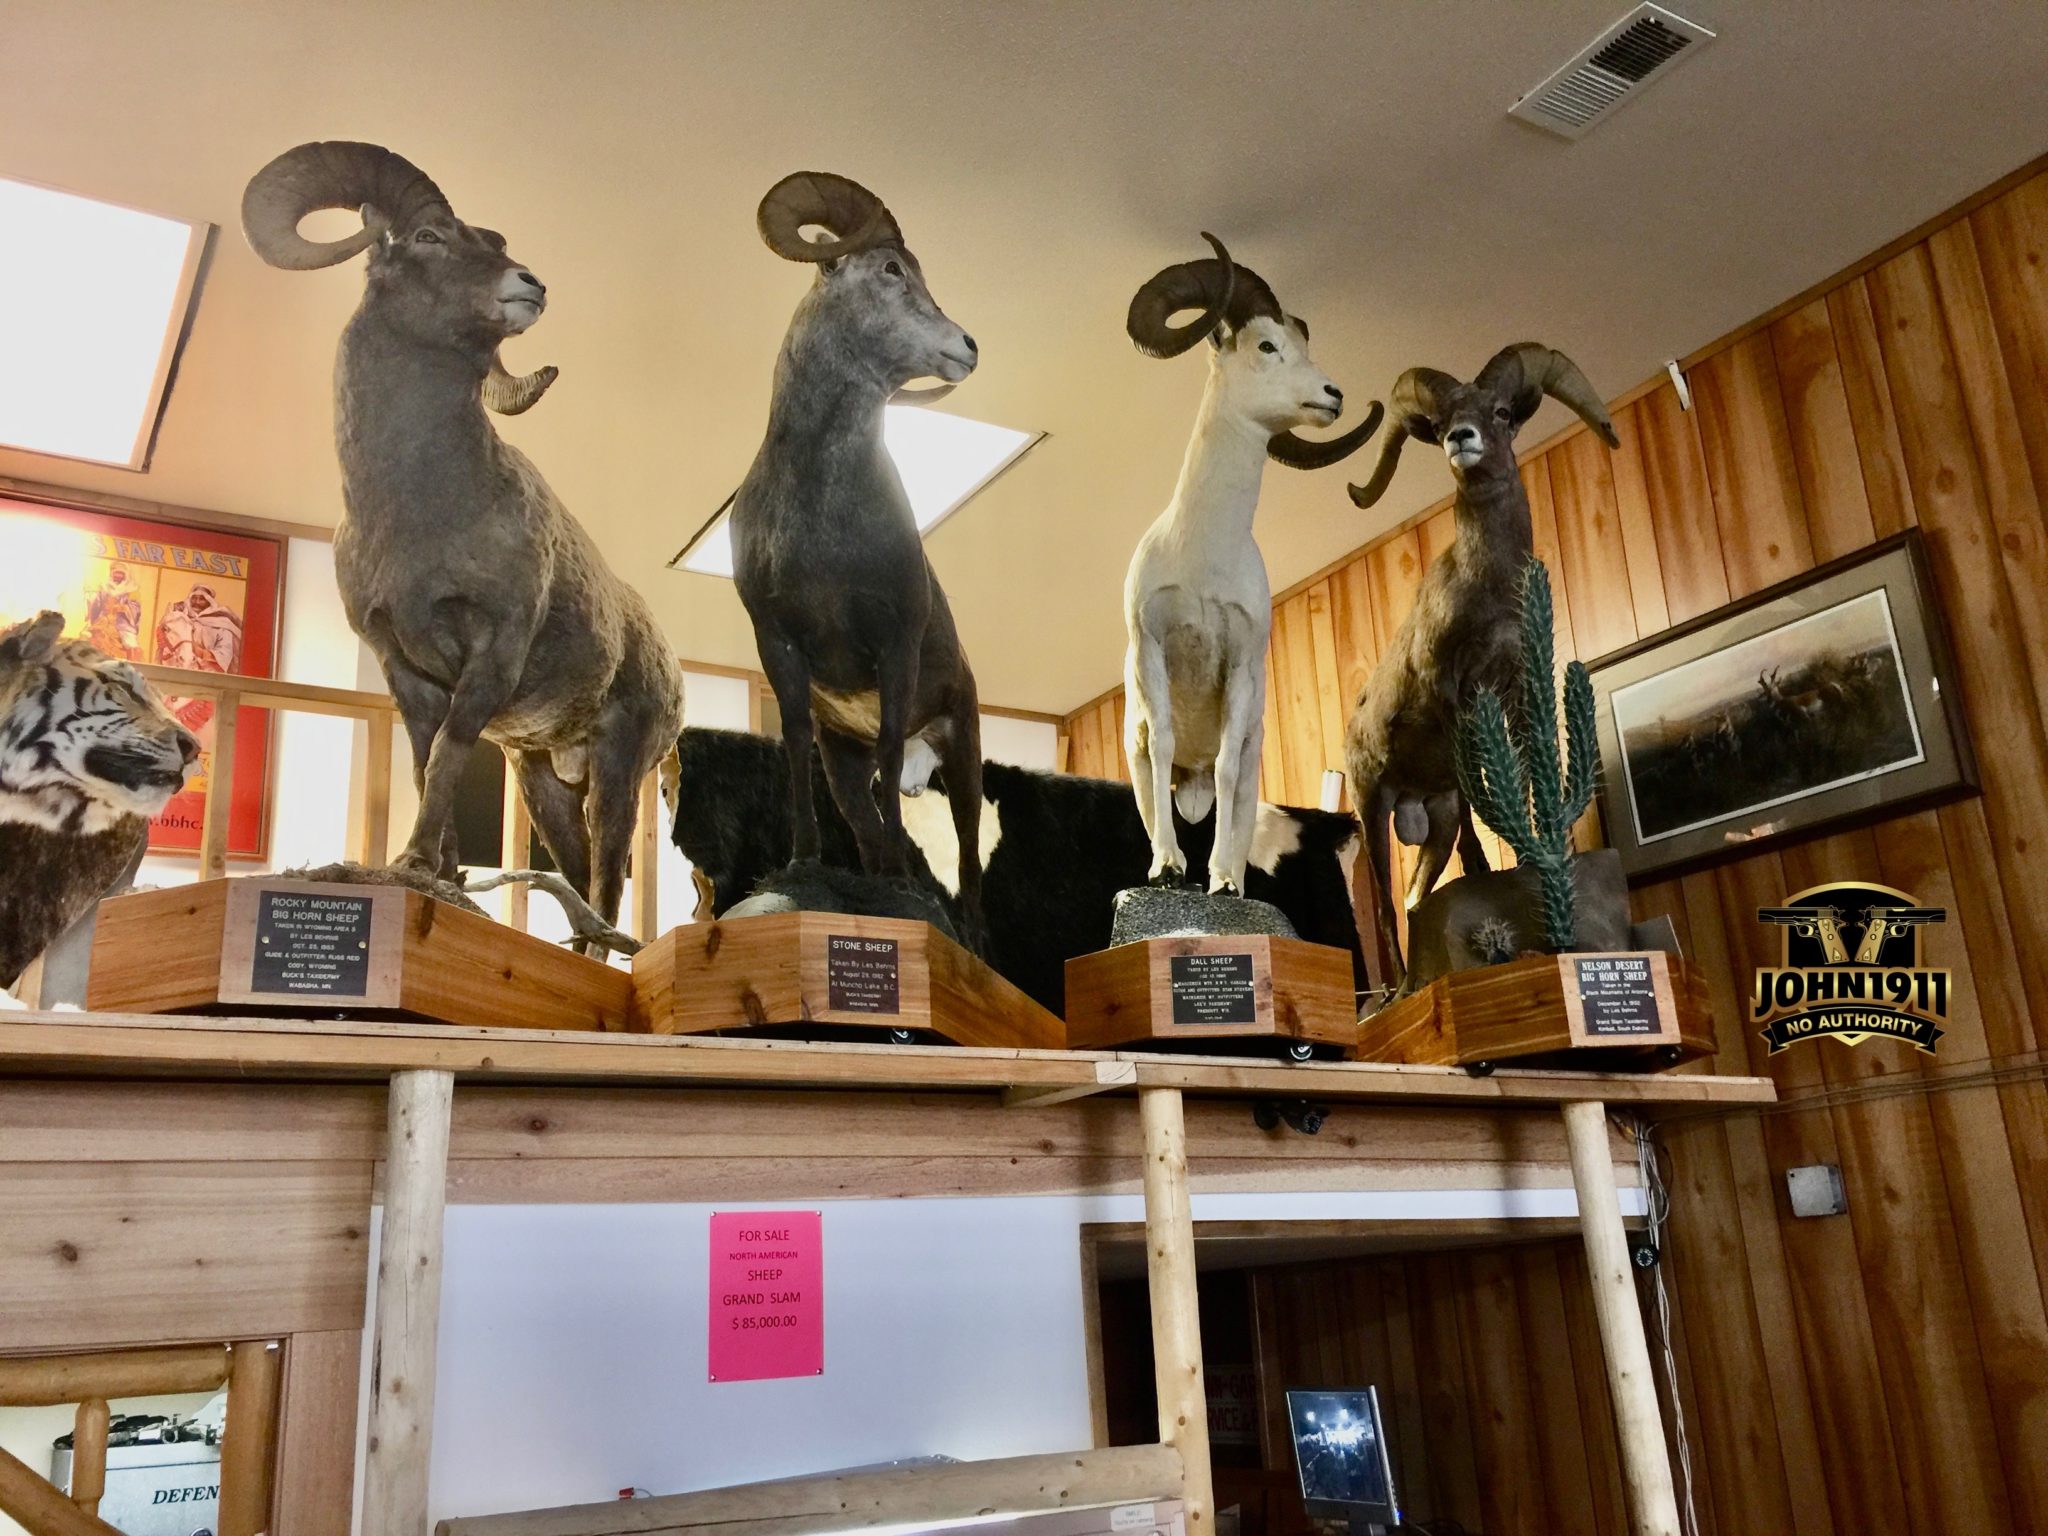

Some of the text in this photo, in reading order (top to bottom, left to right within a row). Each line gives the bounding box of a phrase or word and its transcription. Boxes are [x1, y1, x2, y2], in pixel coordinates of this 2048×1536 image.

[114, 538, 166, 564] FAR
[171, 547, 242, 576] EAST
[272, 898, 362, 911] ROCKY MOUNTAIN
[272, 910, 359, 923] BIG HORN SHEEP
[833, 941, 893, 952] STONE SHEEP
[1582, 961, 1644, 971] NELSON DESERT
[1582, 972, 1647, 981] BIG HORN SHEEP
[739, 1230, 790, 1241] FOR SALE
[729, 1251, 798, 1261] NORTH AMERICAN
[748, 1269, 783, 1281] SHEEP
[723, 1292, 801, 1306] GRAND SLAM
[732, 1315, 797, 1330] $ 85,000.00
